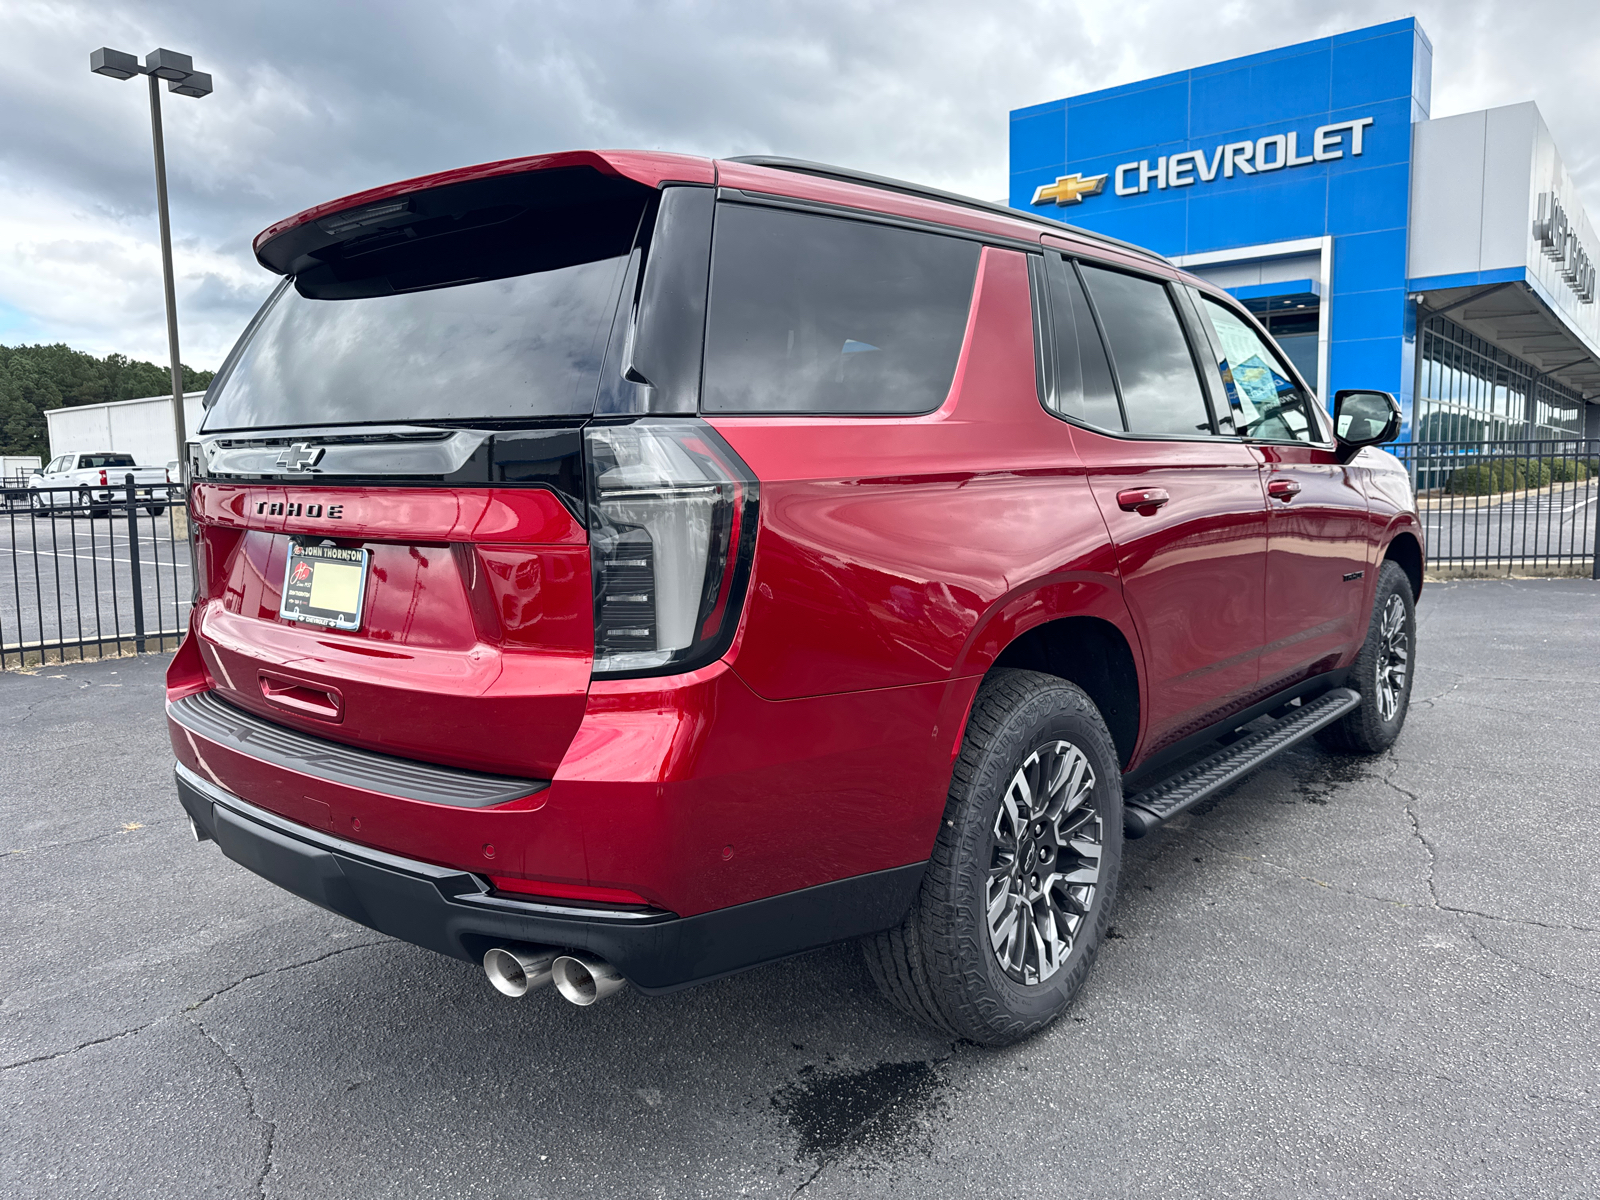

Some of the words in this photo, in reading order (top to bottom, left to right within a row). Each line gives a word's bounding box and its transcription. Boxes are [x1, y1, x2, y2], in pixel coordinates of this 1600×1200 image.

[1114, 117, 1373, 196] CHEVROLET
[256, 502, 344, 519] TAHOE
[304, 546, 322, 557] JOHN
[324, 548, 362, 561] THORNTON
[305, 617, 328, 626] CHEVROLET
